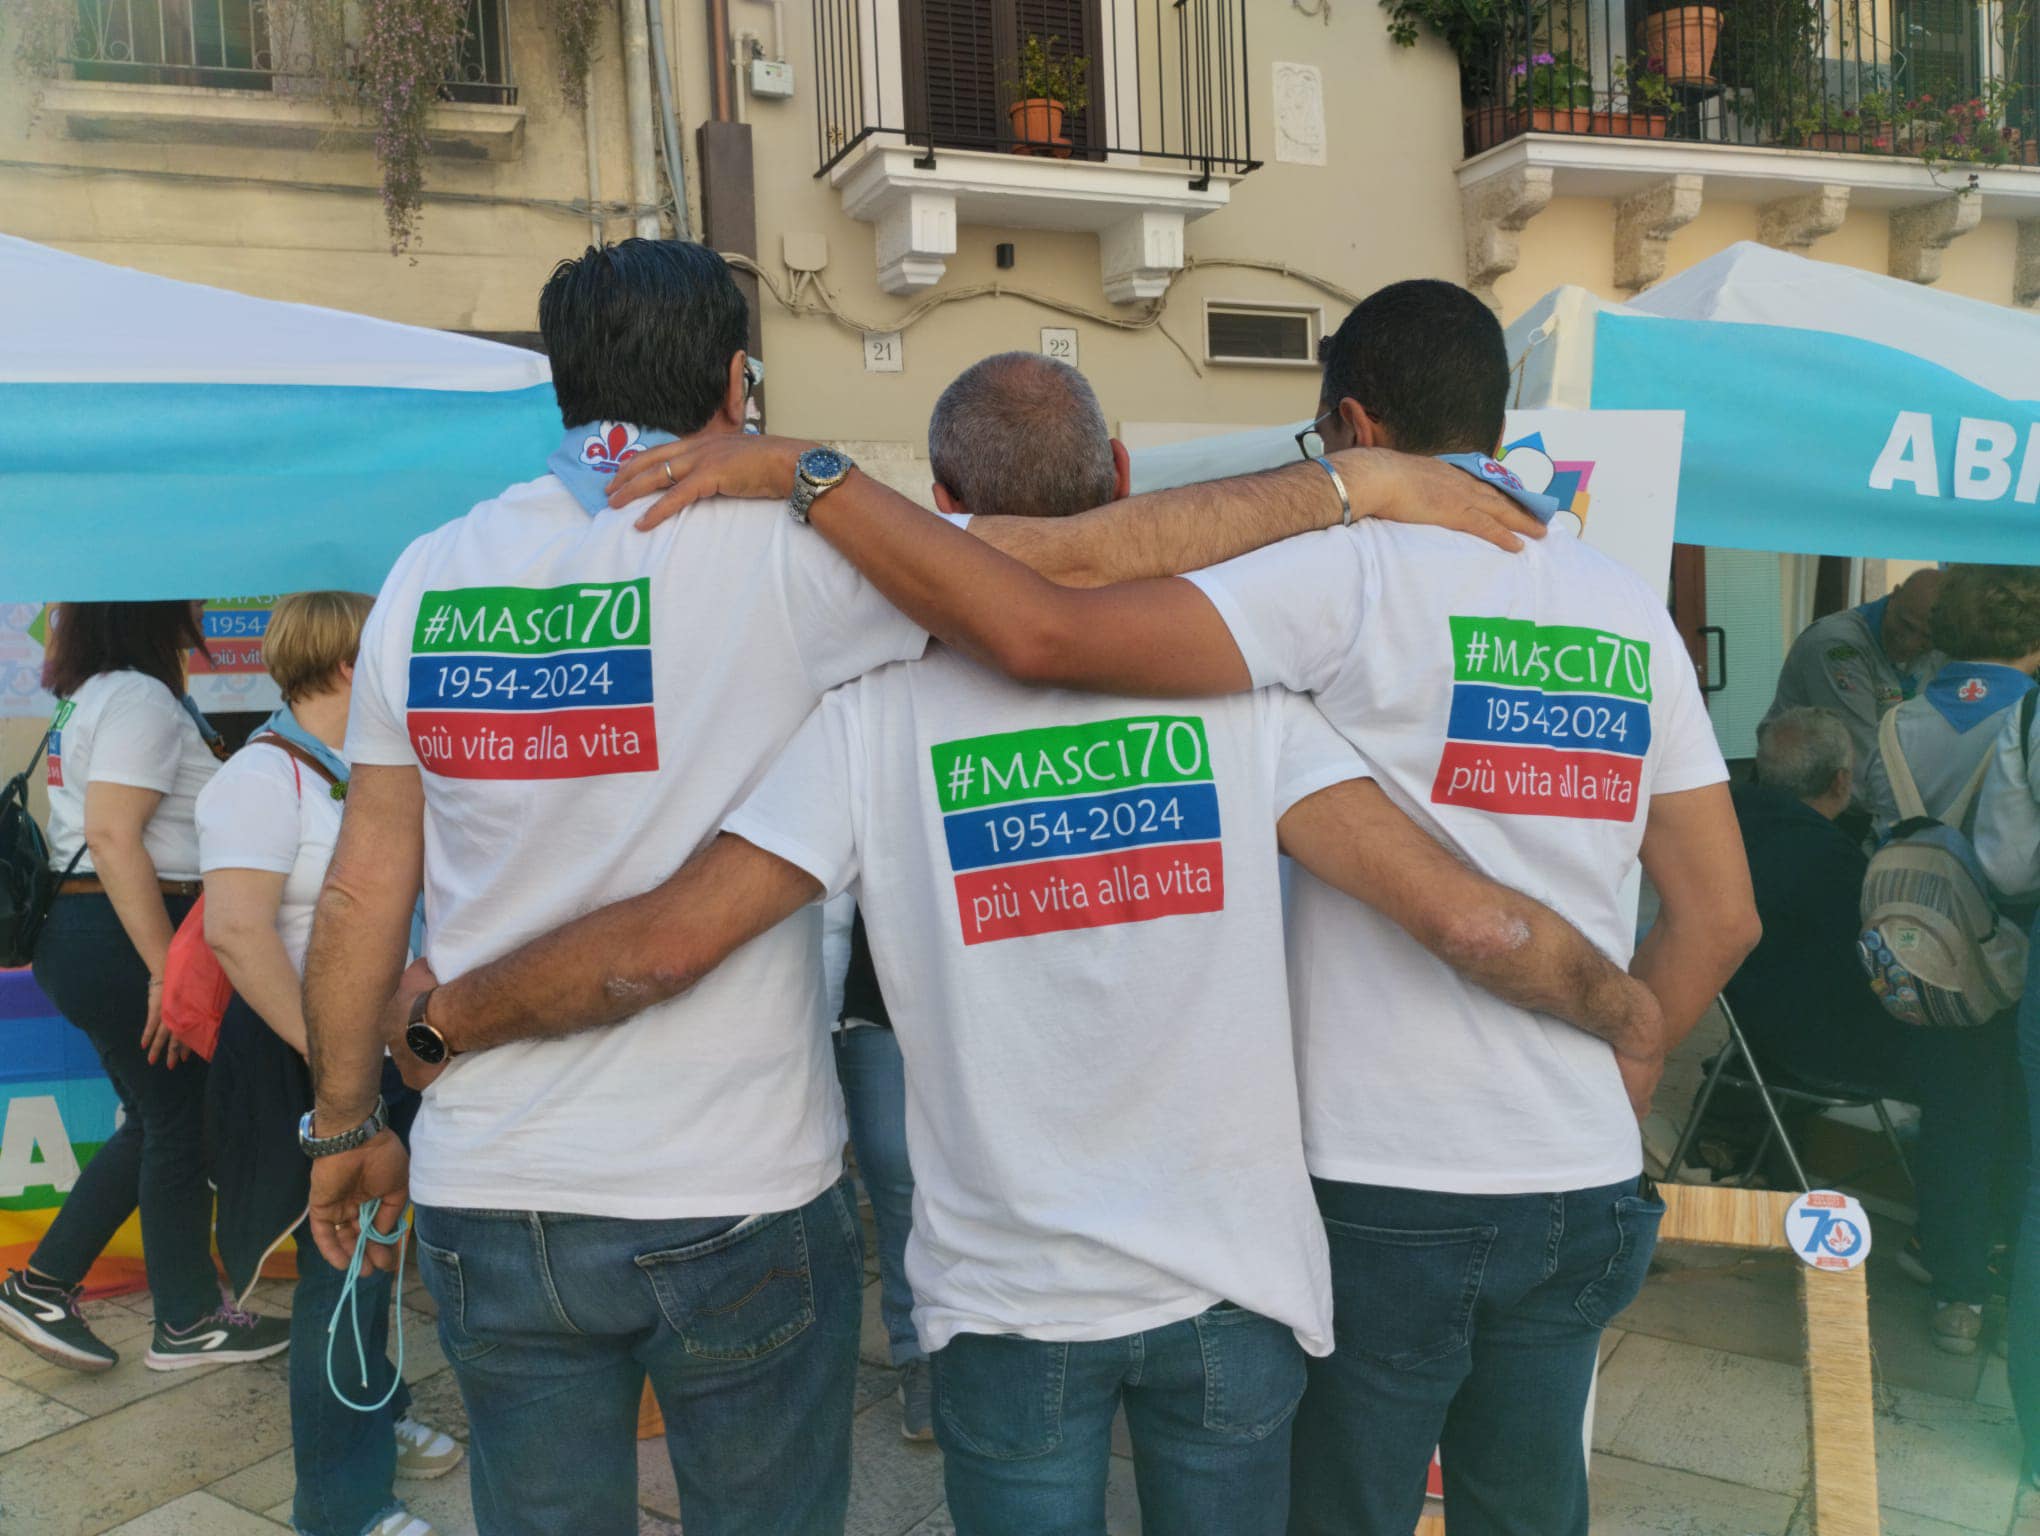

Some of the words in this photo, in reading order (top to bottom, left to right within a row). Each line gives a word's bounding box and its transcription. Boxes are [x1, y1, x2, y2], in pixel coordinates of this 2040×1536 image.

[873, 342, 892, 361] 21
[1049, 339, 1070, 357] 22
[423, 585, 641, 645] #MASCI70
[240, 649, 263, 665] vit
[1465, 630, 1647, 694] #MASCI70
[437, 662, 614, 700] 1954-2024
[1486, 697, 1628, 742] 19542024
[418, 725, 453, 766] più
[461, 726, 514, 760] vita
[524, 725, 569, 760] alla
[579, 723, 642, 758] vita
[948, 721, 1201, 801] #MASCI70
[1447, 759, 1496, 796] più
[1504, 762, 1552, 796] vita
[1559, 764, 1597, 800] alla
[985, 797, 1184, 853] 1954-2024
[972, 882, 1020, 933] più
[1030, 875, 1089, 913] vita
[1097, 864, 1150, 905] alla
[1156, 859, 1212, 895] vita
[1799, 1208, 1862, 1257] 70
